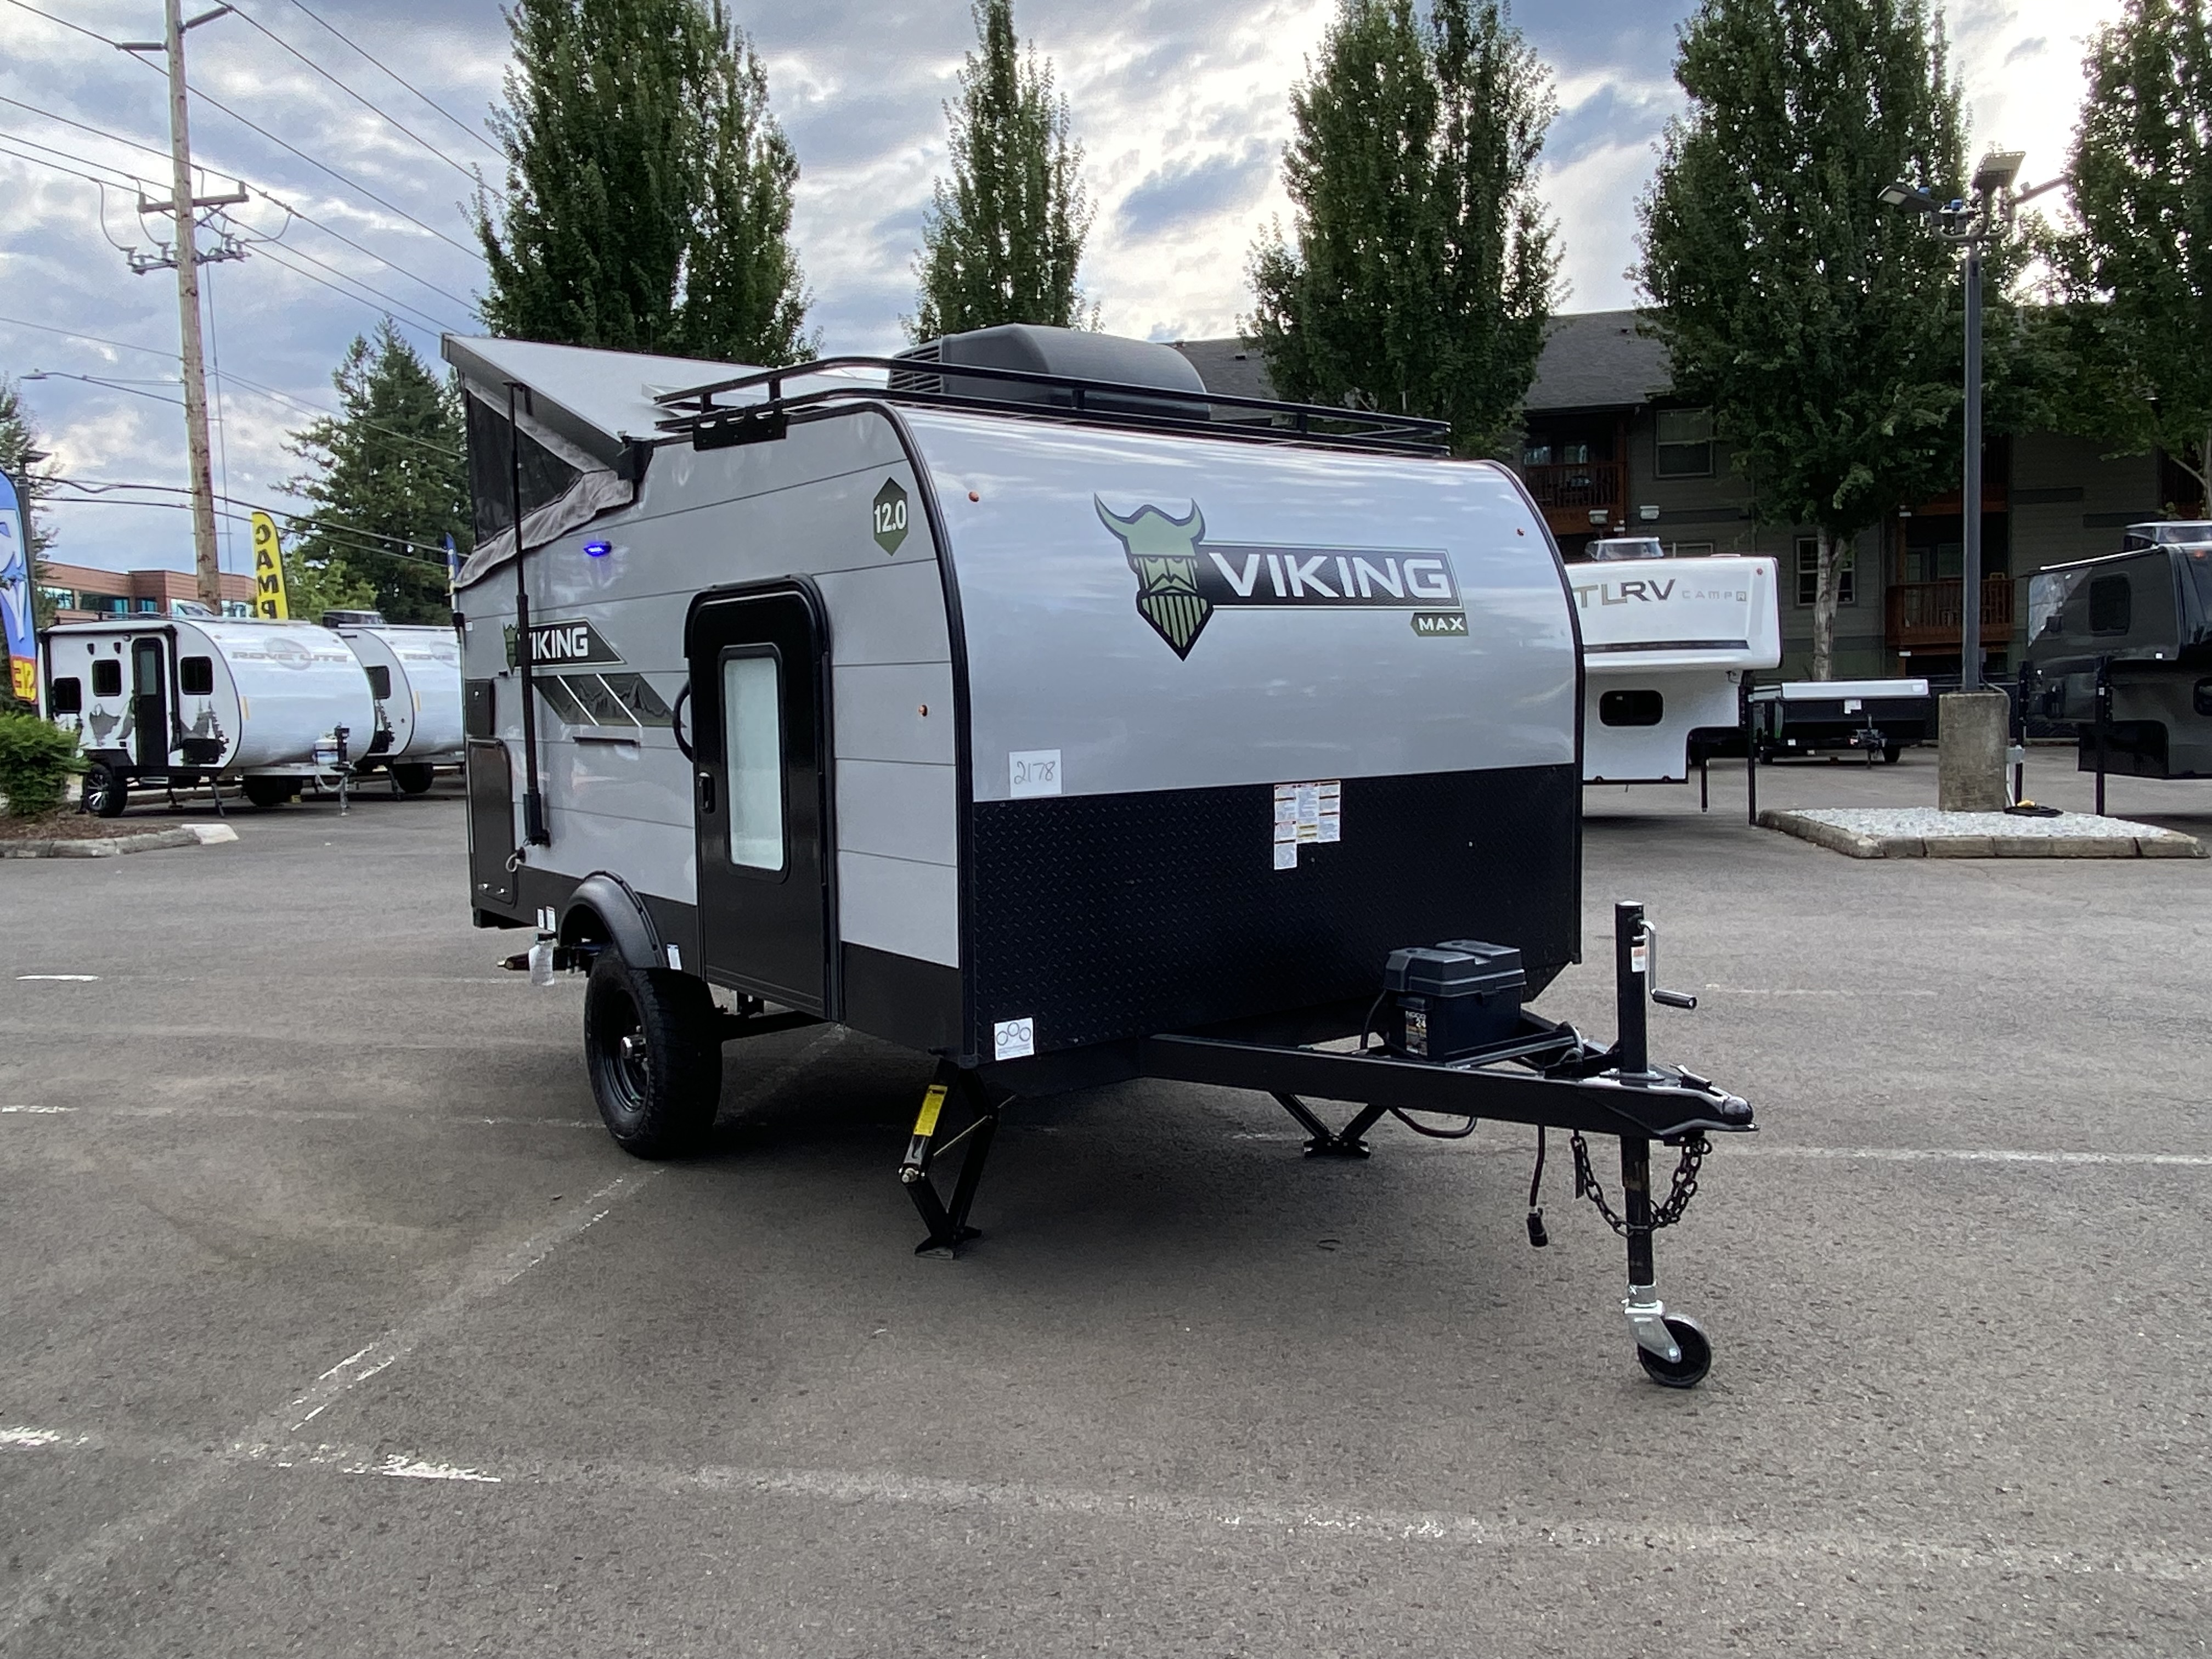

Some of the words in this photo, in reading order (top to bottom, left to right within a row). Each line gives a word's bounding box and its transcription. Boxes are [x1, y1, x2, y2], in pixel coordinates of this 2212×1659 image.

[874, 500, 906, 533] 12.0
[1209, 552, 1452, 598] VIKING
[1572, 579, 1675, 608] TLRV
[1418, 617, 1464, 631] MAX
[517, 627, 589, 659] IKING
[1014, 760, 1056, 785] 2178
